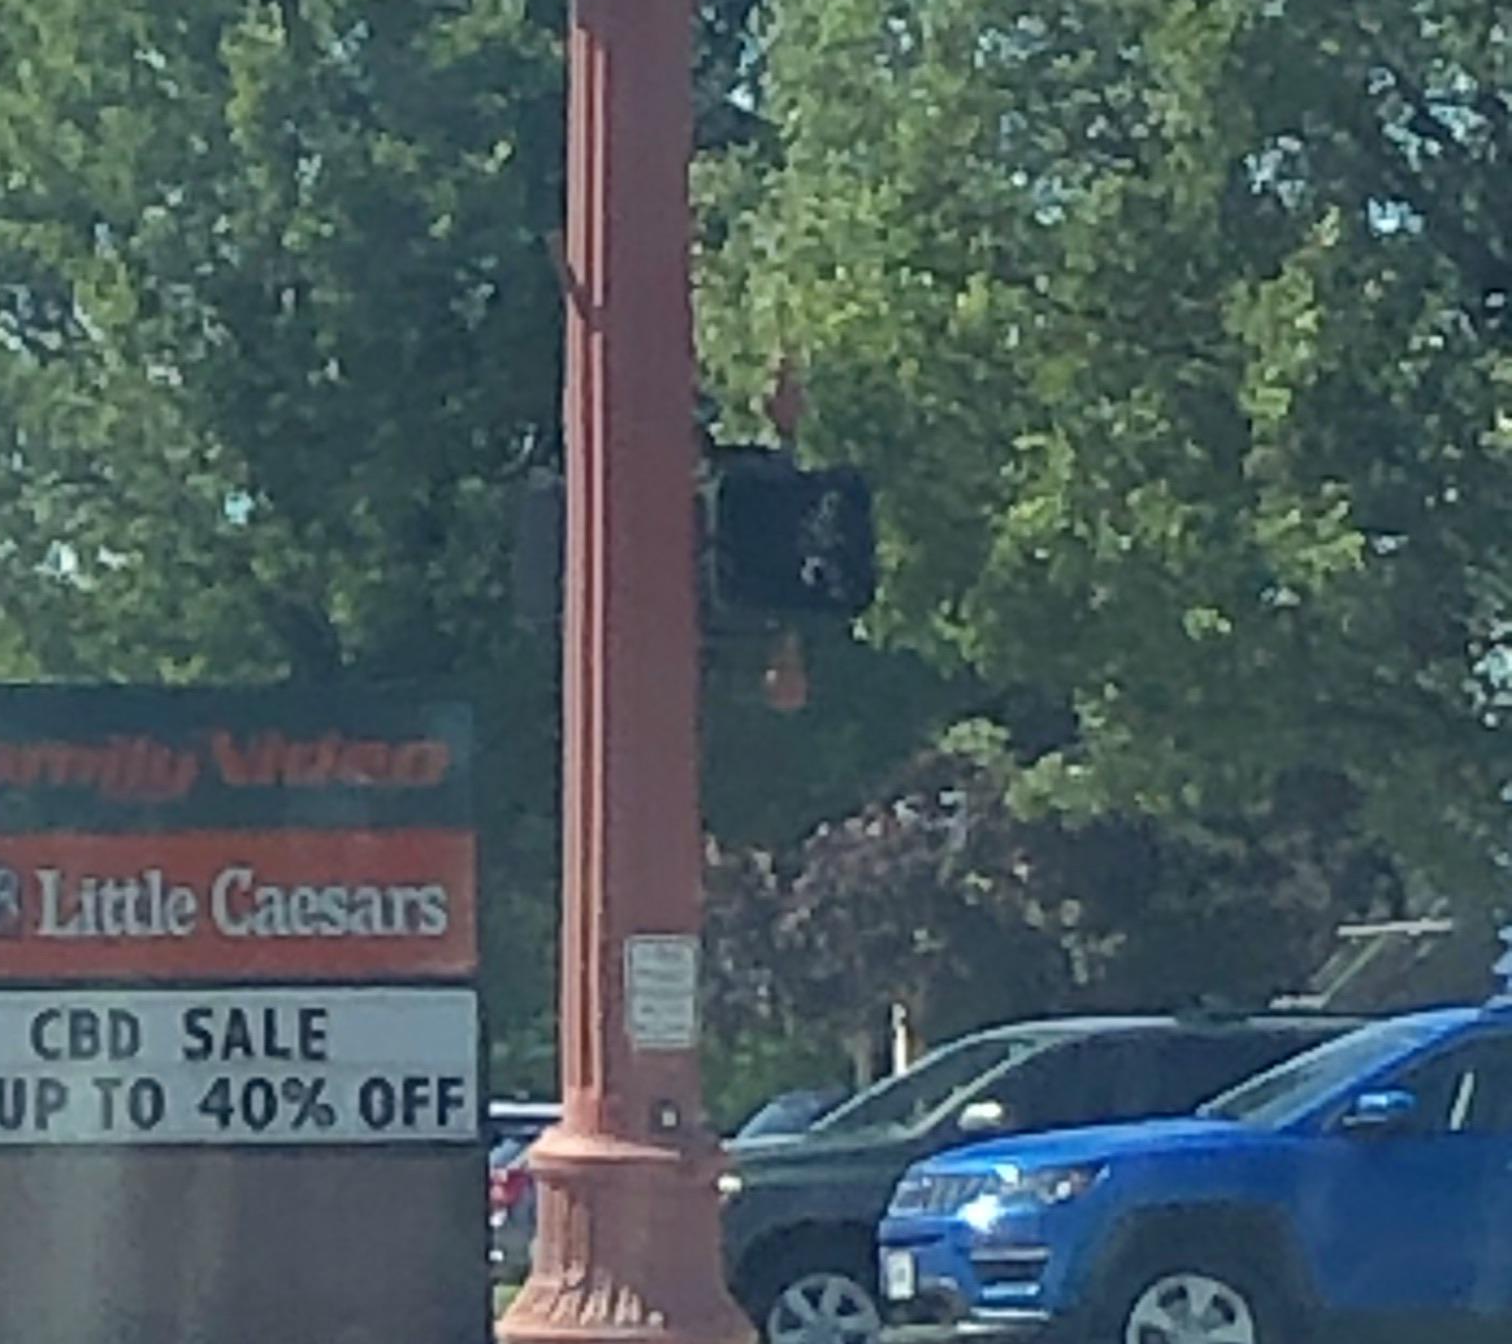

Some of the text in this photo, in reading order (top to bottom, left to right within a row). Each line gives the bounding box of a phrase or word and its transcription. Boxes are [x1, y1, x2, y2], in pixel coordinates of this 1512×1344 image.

[35, 867, 449, 938] Little Caesars
[30, 1007, 328, 1061] CBD SALE
[91, 1077, 165, 1131] TO
[197, 1076, 336, 1131] 40%
[358, 1076, 465, 1131] OFF
